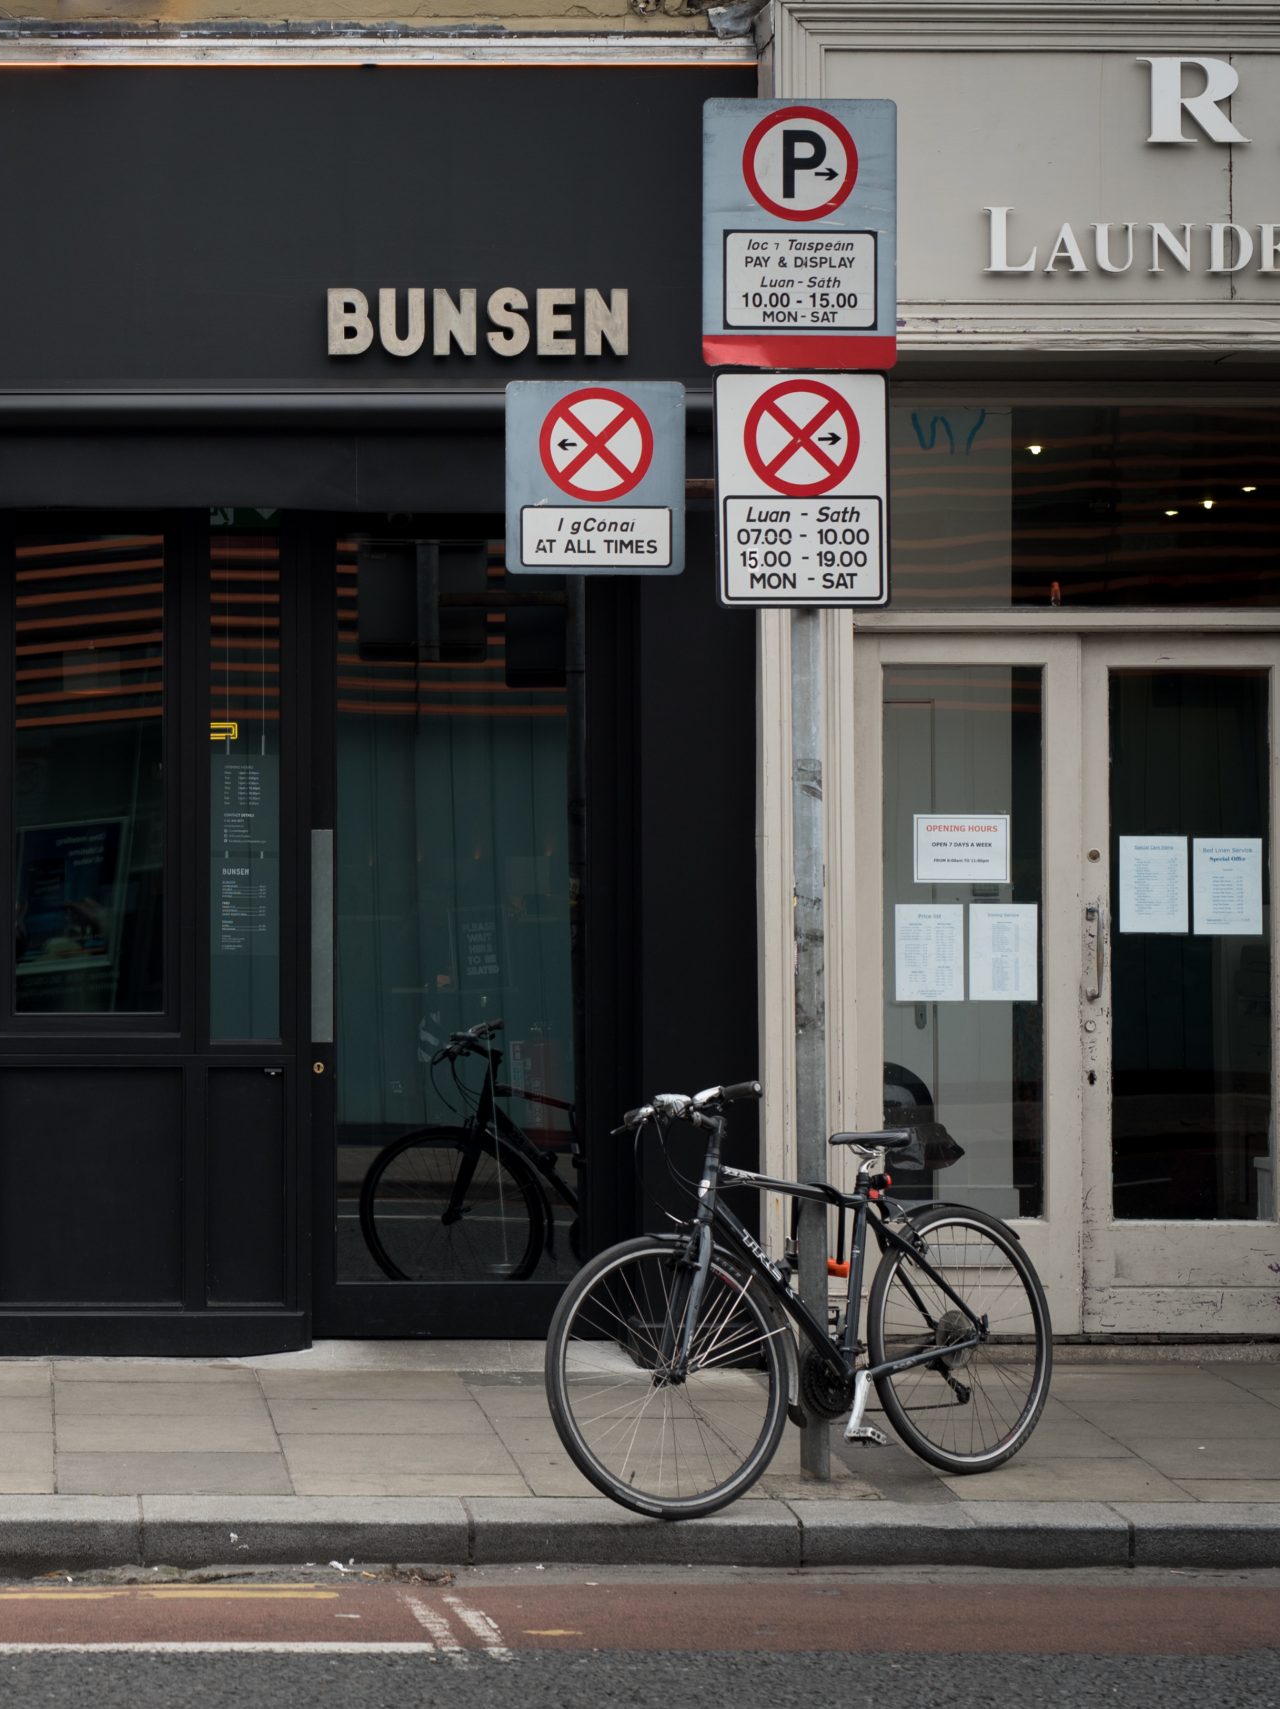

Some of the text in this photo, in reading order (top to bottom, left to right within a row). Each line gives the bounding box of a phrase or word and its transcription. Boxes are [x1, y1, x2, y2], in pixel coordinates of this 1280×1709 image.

[782, 129, 827, 199] P
[745, 256, 856, 268] PAY & DISPLAY
[742, 293, 790, 308] 10.00
[809, 293, 858, 308] 15.00
[327, 287, 629, 358] BUNSEN
[746, 506, 791, 523] Luan
[816, 506, 860, 523] Sath
[737, 528, 792, 545] 07.00
[817, 528, 870, 545] 10.00
[535, 539, 658, 554] AT ALL TIMES
[740, 550, 792, 569] 15.00
[816, 550, 868, 568] 19.00
[750, 573, 797, 590] MON
[822, 573, 858, 590] SAT
[926, 824, 998, 833] OPENING HOURS
[222, 867, 250, 876] BUNSEN
[467, 955, 481, 965] TO
